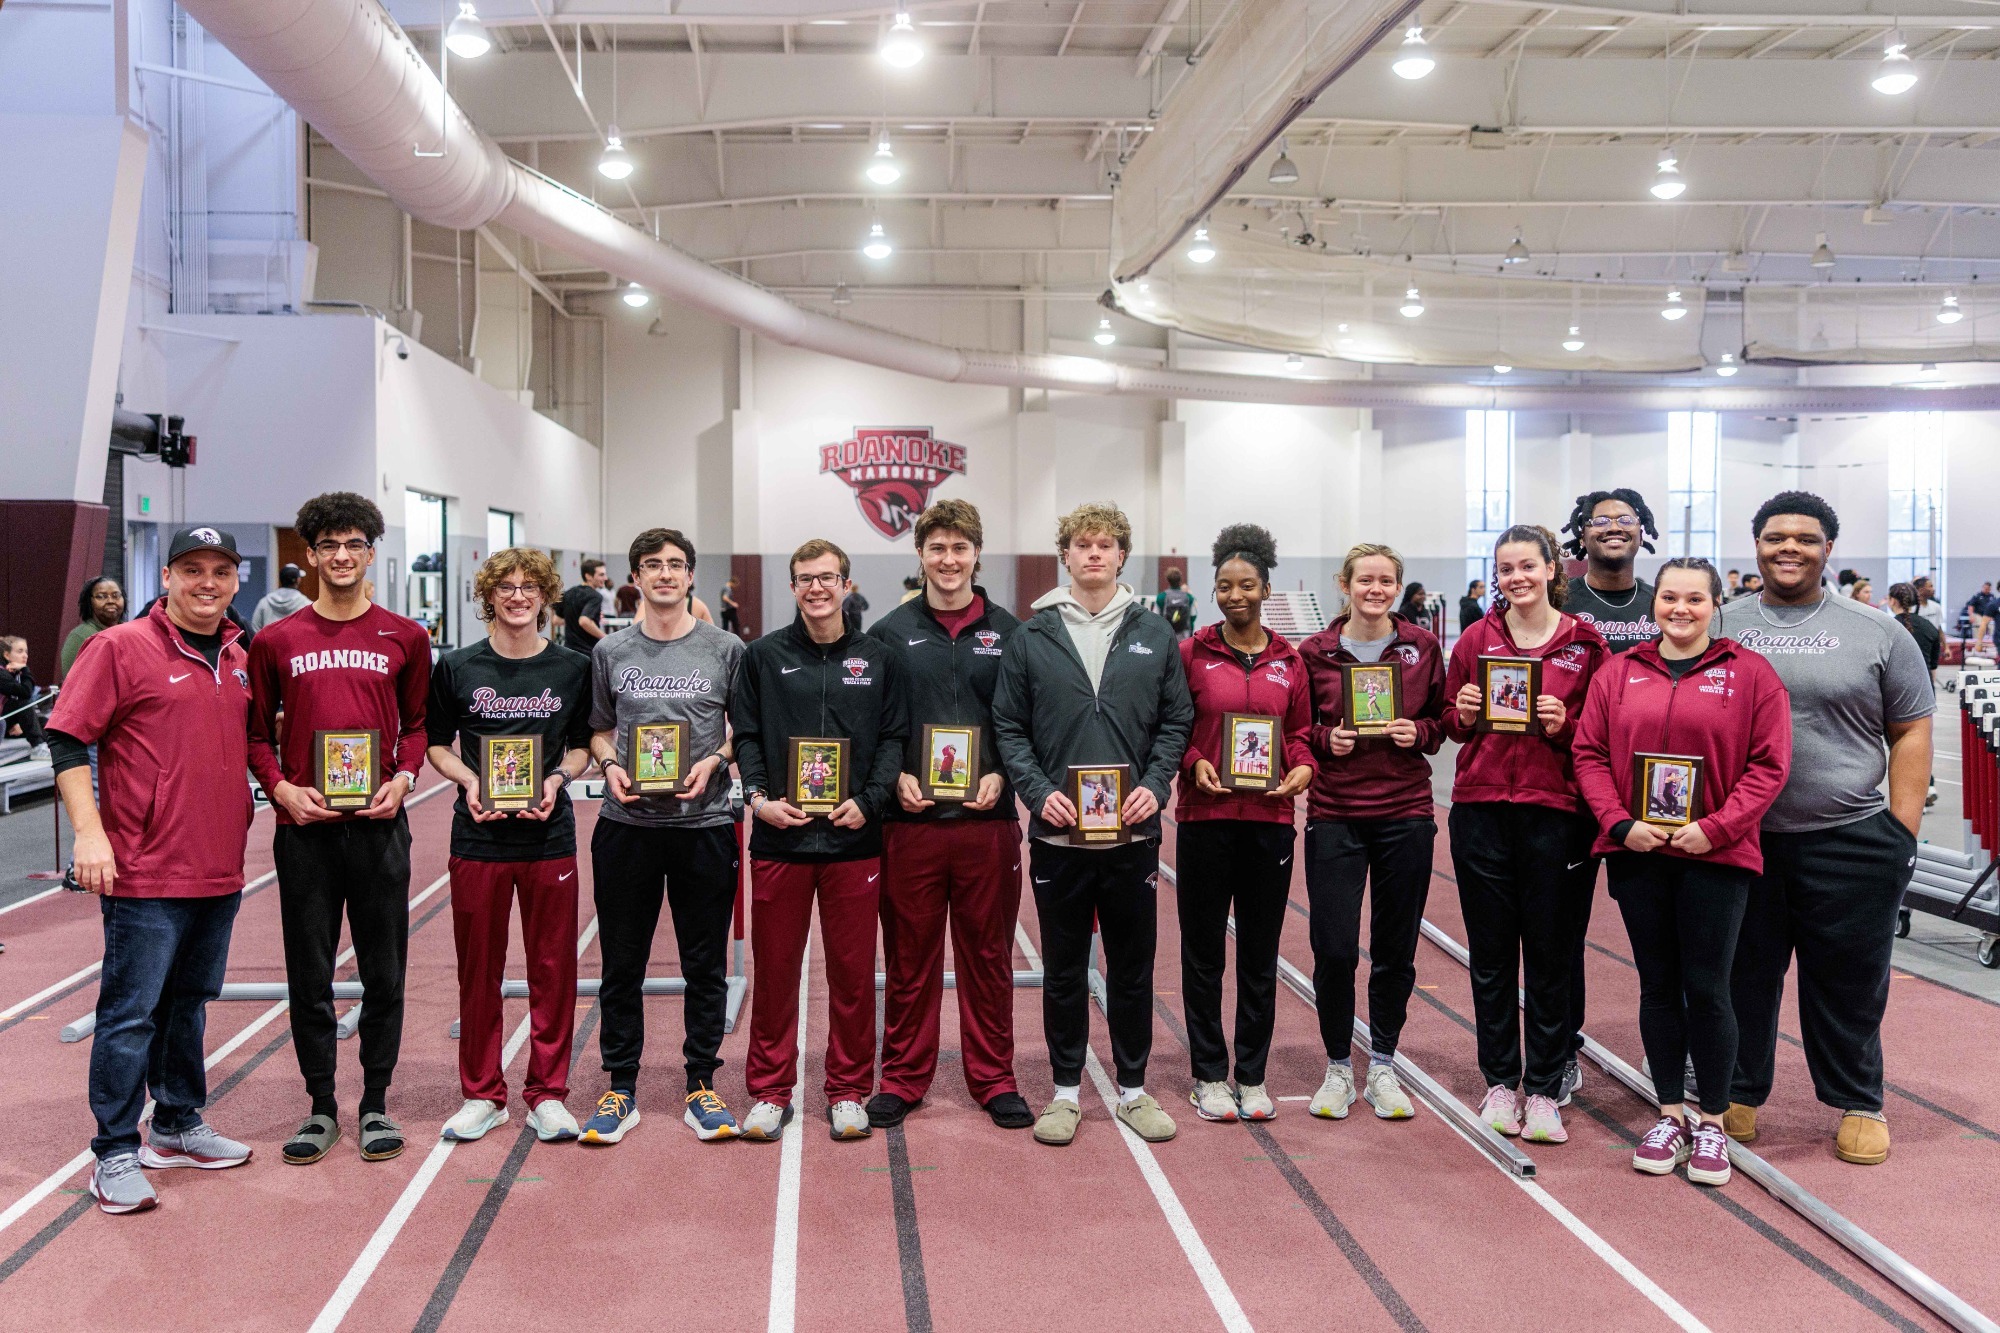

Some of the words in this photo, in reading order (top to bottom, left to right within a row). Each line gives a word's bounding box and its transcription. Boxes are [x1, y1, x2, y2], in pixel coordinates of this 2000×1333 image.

[821, 437, 965, 474] ROANOKE
[851, 465, 937, 482] MAROONS
[1738, 628, 1840, 650] Roanoke
[290, 649, 389, 678] ROANOKE
[617, 666, 712, 693] Roanoke
[469, 687, 562, 713] Roanoke
